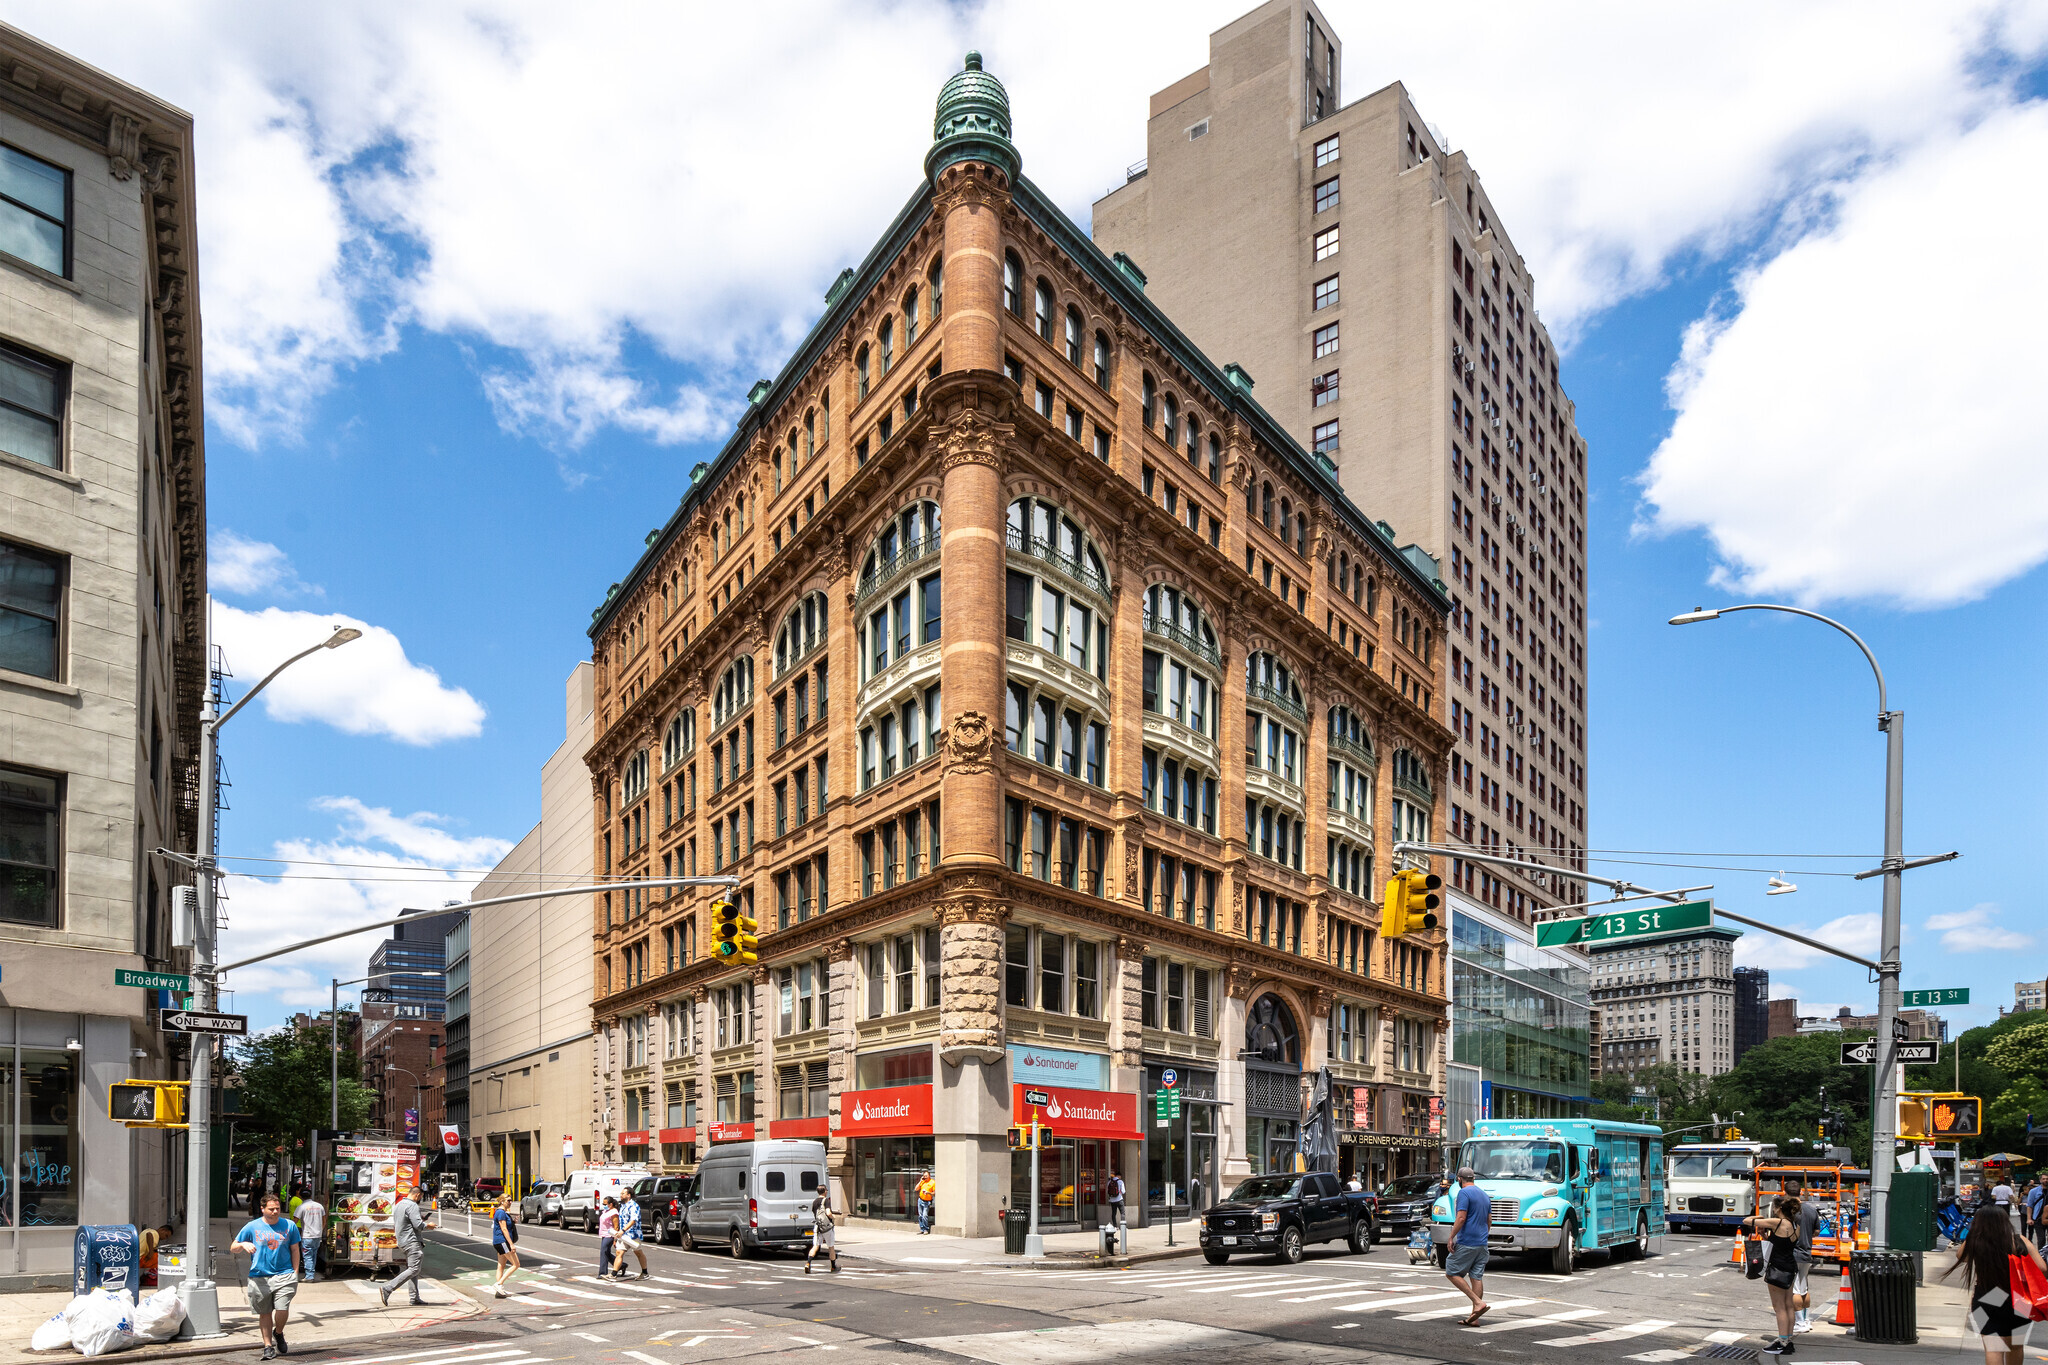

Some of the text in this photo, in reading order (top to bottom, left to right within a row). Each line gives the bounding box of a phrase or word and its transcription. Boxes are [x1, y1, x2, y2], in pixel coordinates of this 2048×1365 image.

[1581, 911, 1661, 938] E 13 St
[124, 972, 183, 991] Broadway
[1912, 990, 1958, 1005] E 13 St
[175, 1016, 237, 1029] ONE WAY
[1896, 1048, 1924, 1057] WAY
[1035, 1056, 1078, 1071] Santander
[865, 1098, 910, 1120] Santander
[1064, 1100, 1117, 1121] Santander
[1341, 1134, 1440, 1148] MAX BRENNER CHOCOLATE BAR
[610, 1178, 621, 1186] TA
